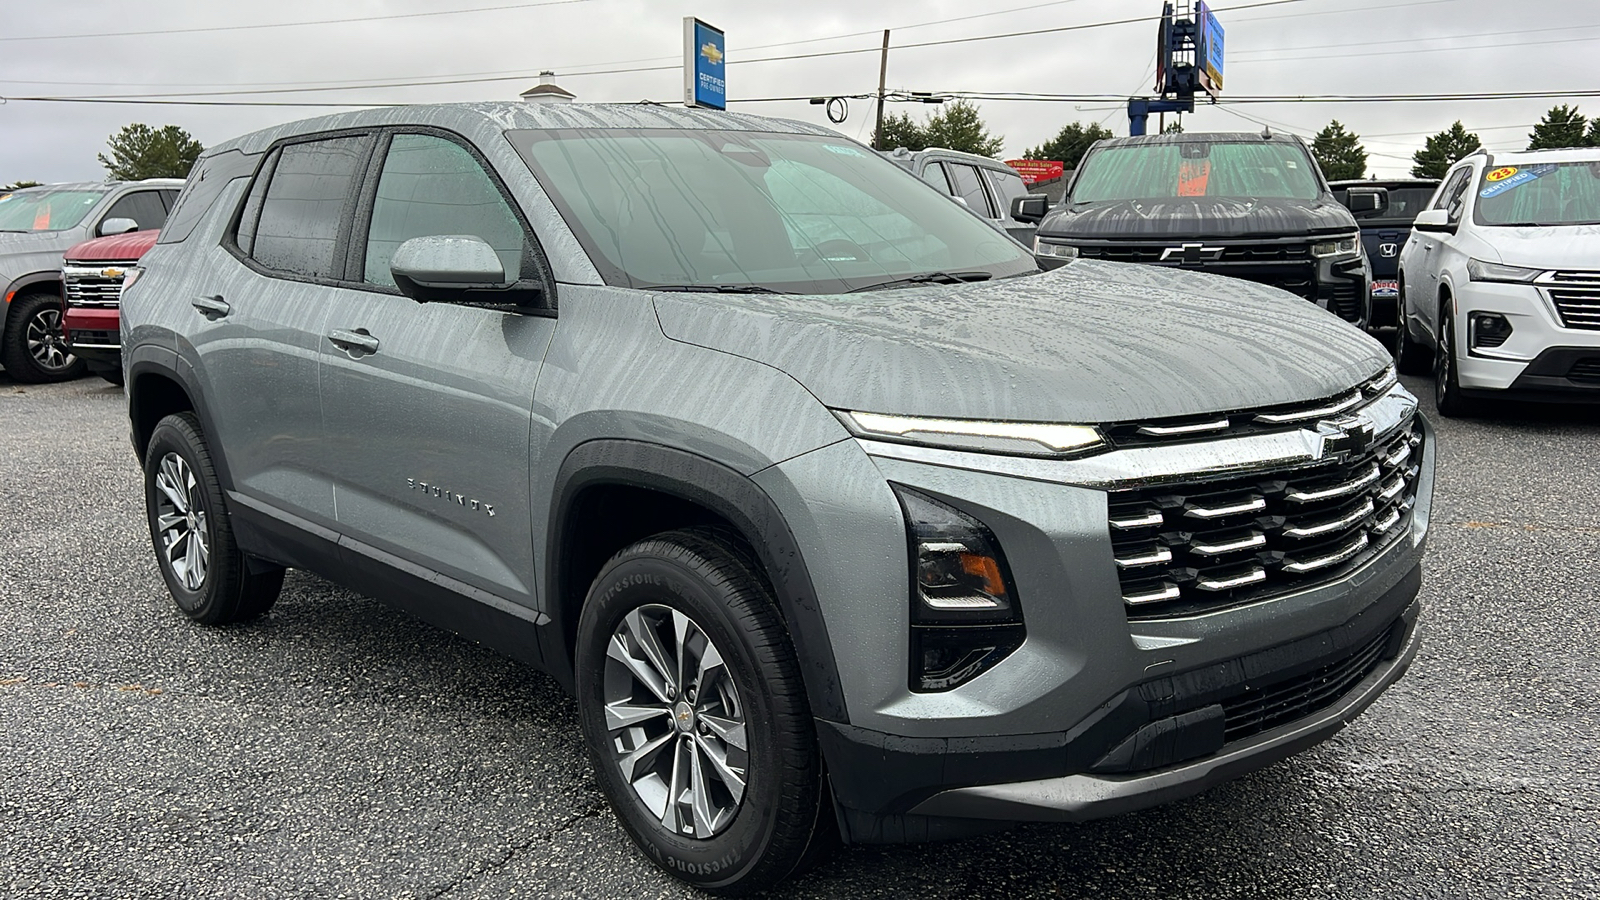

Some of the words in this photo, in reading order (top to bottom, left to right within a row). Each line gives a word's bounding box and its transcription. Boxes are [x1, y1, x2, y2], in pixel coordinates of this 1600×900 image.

[700, 72, 724, 87] CERTIFIED
[701, 81, 724, 95] PRE-OWNED
[1481, 173, 1529, 195] CERTIFIED
[1492, 167, 1512, 180] 23
[407, 477, 495, 517] EQUINOX
[599, 573, 662, 609] Firestone
[667, 848, 742, 876] Firestone
